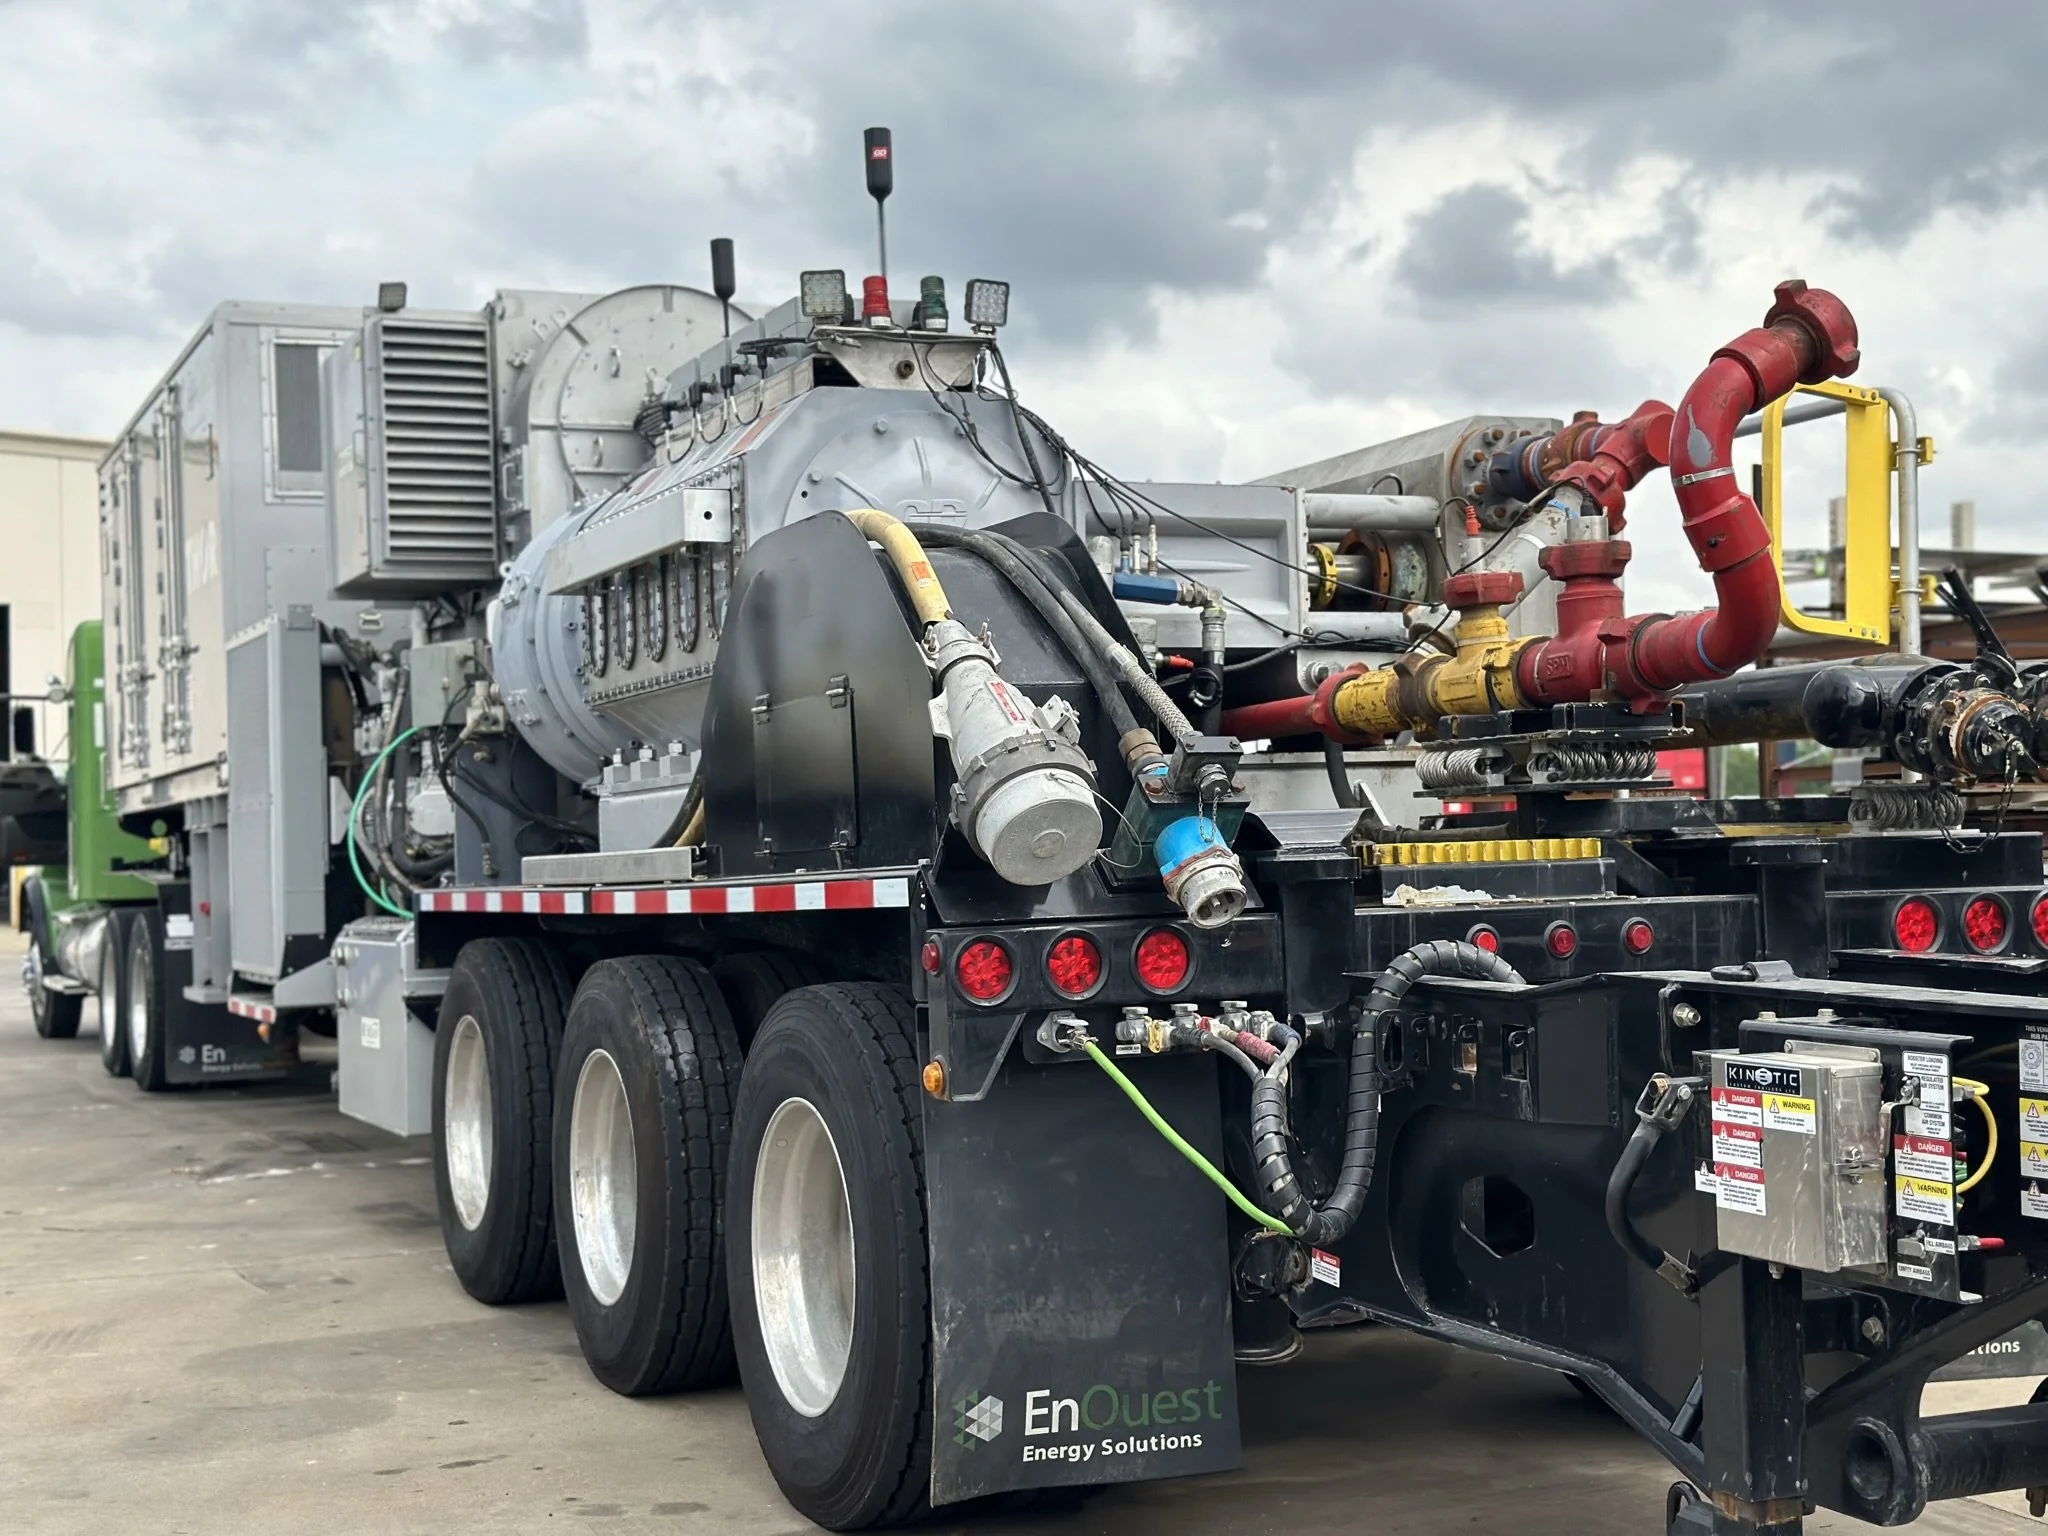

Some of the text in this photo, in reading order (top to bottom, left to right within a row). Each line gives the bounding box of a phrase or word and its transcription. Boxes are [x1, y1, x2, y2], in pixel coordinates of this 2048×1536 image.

[2024, 1024, 2036, 1032] THIS
[1907, 1054, 1943, 1064] BOOSTER LOADING
[1728, 1067, 1798, 1086] KINETIC
[1731, 1094, 1756, 1105] DANGER
[1782, 1100, 1811, 1111] WARNING
[1923, 1112, 1943, 1120] COMMON
[1929, 1119, 1946, 1127] SYSTEM
[1732, 1129, 1757, 1139] DANGER
[1917, 1143, 1945, 1153] DANGER
[1735, 1170, 1759, 1181] DANGER
[1917, 1184, 1948, 1195] WARNING
[1024, 1379, 1222, 1436] EnQuest
[1022, 1433, 1203, 1463] Energy Solutions
